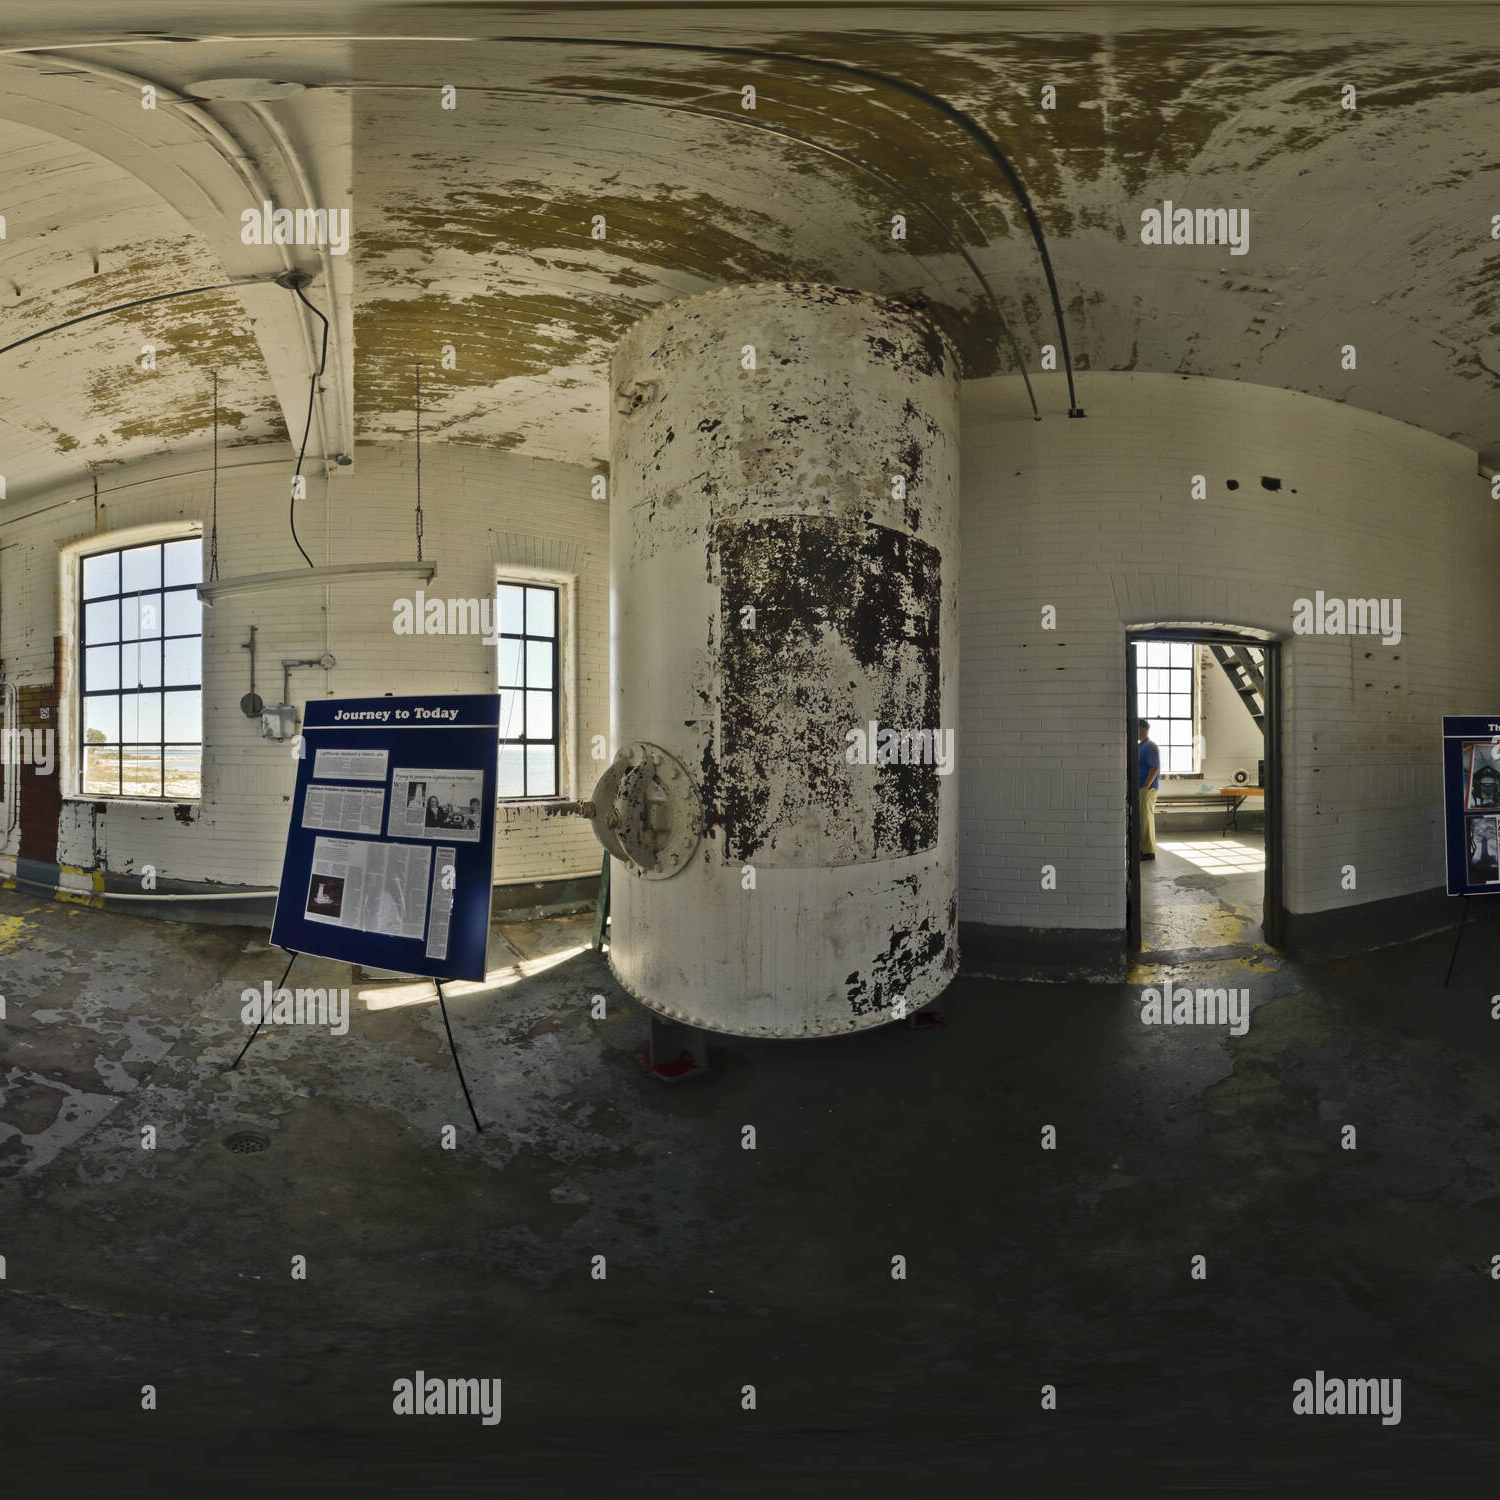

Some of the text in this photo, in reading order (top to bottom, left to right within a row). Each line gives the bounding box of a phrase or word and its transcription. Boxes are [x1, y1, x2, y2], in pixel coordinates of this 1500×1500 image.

[334, 707, 459, 721] Journey to Today
